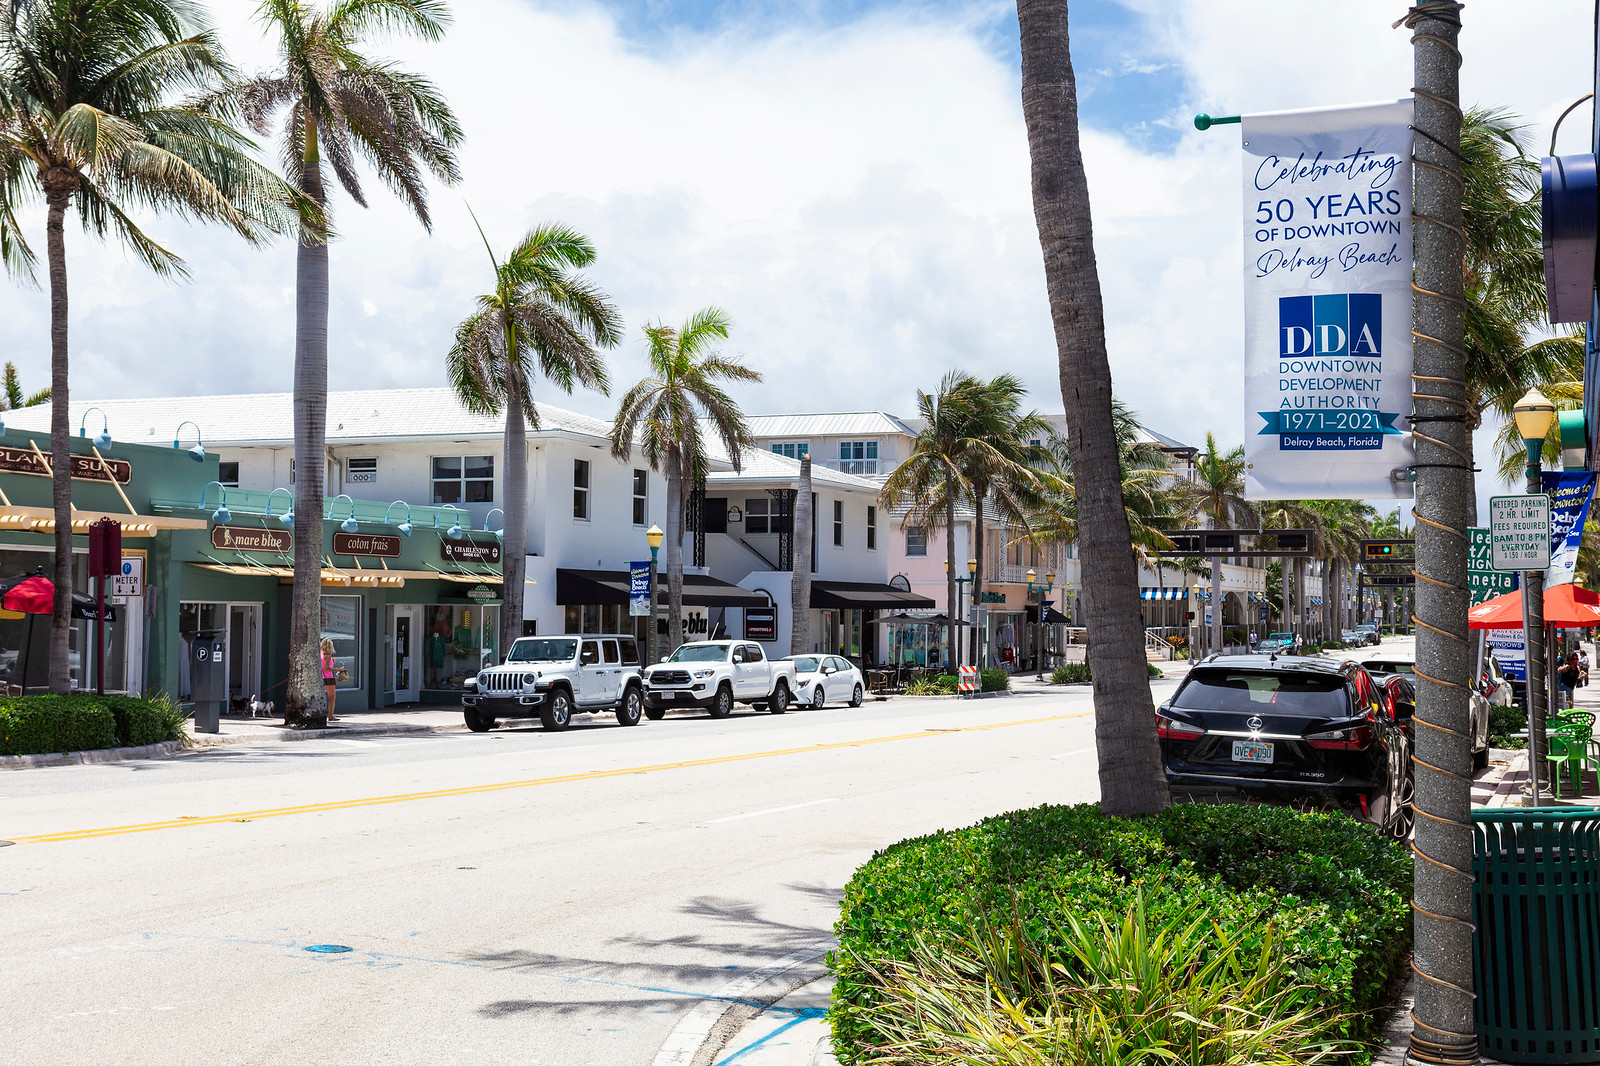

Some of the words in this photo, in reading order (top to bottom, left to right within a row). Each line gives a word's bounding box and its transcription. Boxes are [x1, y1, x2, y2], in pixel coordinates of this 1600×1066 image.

[1255, 147, 1402, 190] Celebrating
[1256, 199, 1294, 224] 50
[1305, 190, 1401, 219] YEARS
[1255, 229, 1279, 242] OF
[1284, 220, 1400, 240] DOWNTOWN
[1256, 247, 1335, 279] Delray
[1338, 243, 1402, 272] Beach
[1282, 323, 1380, 354] DDA
[1279, 360, 1382, 374] DOWNTOWN
[1279, 378, 1382, 391] DEVELOPMENT
[1280, 395, 1381, 409] AUTHORITY
[1284, 436, 1314, 448] Delray
[1316, 436, 1346, 447] Beach,
[1348, 436, 1379, 446] Florida
[78, 460, 118, 473] SUN
[1582, 484, 1592, 493] to
[1492, 500, 1519, 509] METERED
[1520, 499, 1546, 508] PARKING
[1499, 511, 1504, 519] 2
[1506, 510, 1518, 519] HR.
[1521, 509, 1540, 518] LIMIT
[1493, 523, 1511, 531] FEES
[1513, 521, 1547, 530] REQUIRED
[235, 535, 260, 546] mare
[261, 533, 282, 547] blue
[1516, 533, 1526, 541] TO
[1535, 533, 1547, 541] PM
[347, 537, 369, 549] coton
[369, 537, 389, 553] frais
[1501, 543, 1540, 551] EVERYDAY
[115, 576, 138, 584] METER
